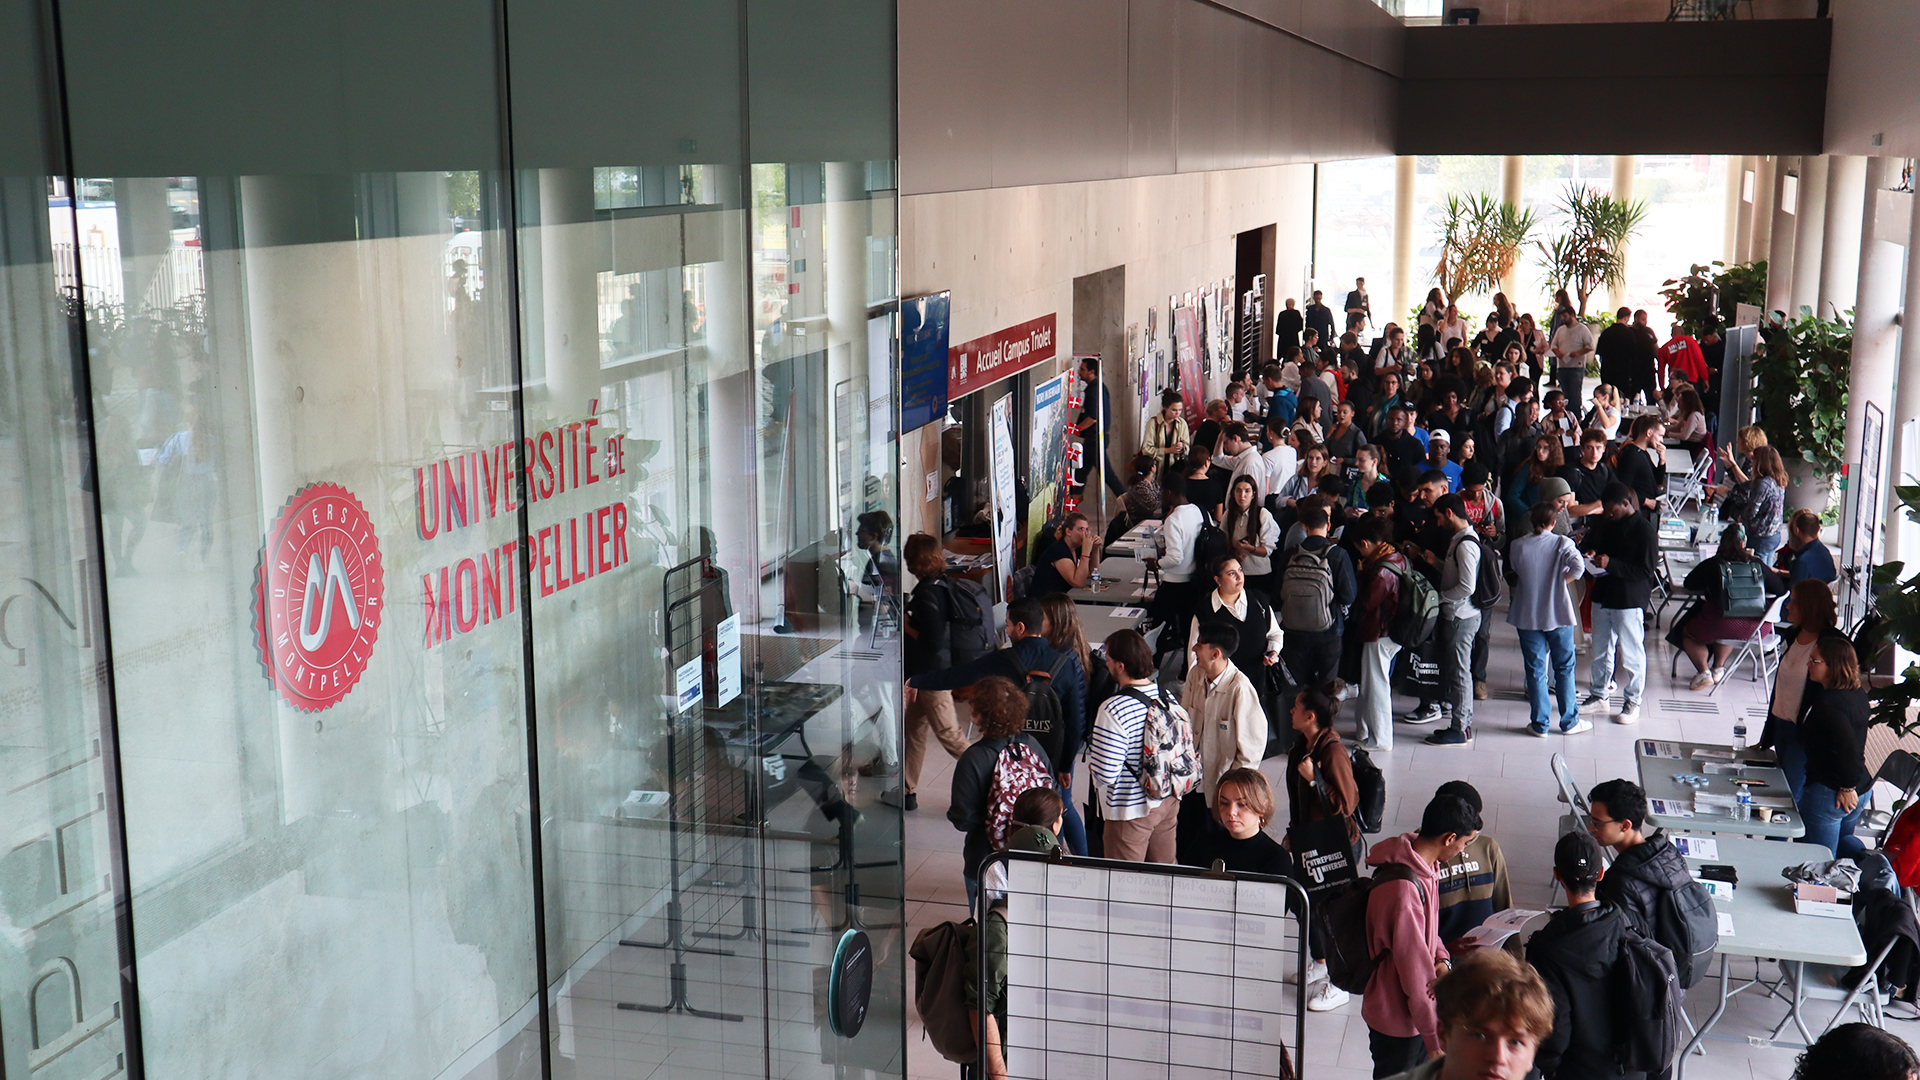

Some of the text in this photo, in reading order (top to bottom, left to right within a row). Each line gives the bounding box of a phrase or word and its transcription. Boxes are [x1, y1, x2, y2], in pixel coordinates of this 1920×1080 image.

[976, 340, 1003, 374] Accueil
[1003, 337, 1030, 363] Campus
[1030, 325, 1051, 351] Triolet
[413, 398, 626, 541] UNIVERSITÉ DE
[420, 501, 629, 650] MONTPELLIER
[277, 596, 378, 691] MONTPELLIER
[1306, 851, 1344, 876] ENTREPRISES
[1312, 857, 1348, 883] UNIVERSITÉ
